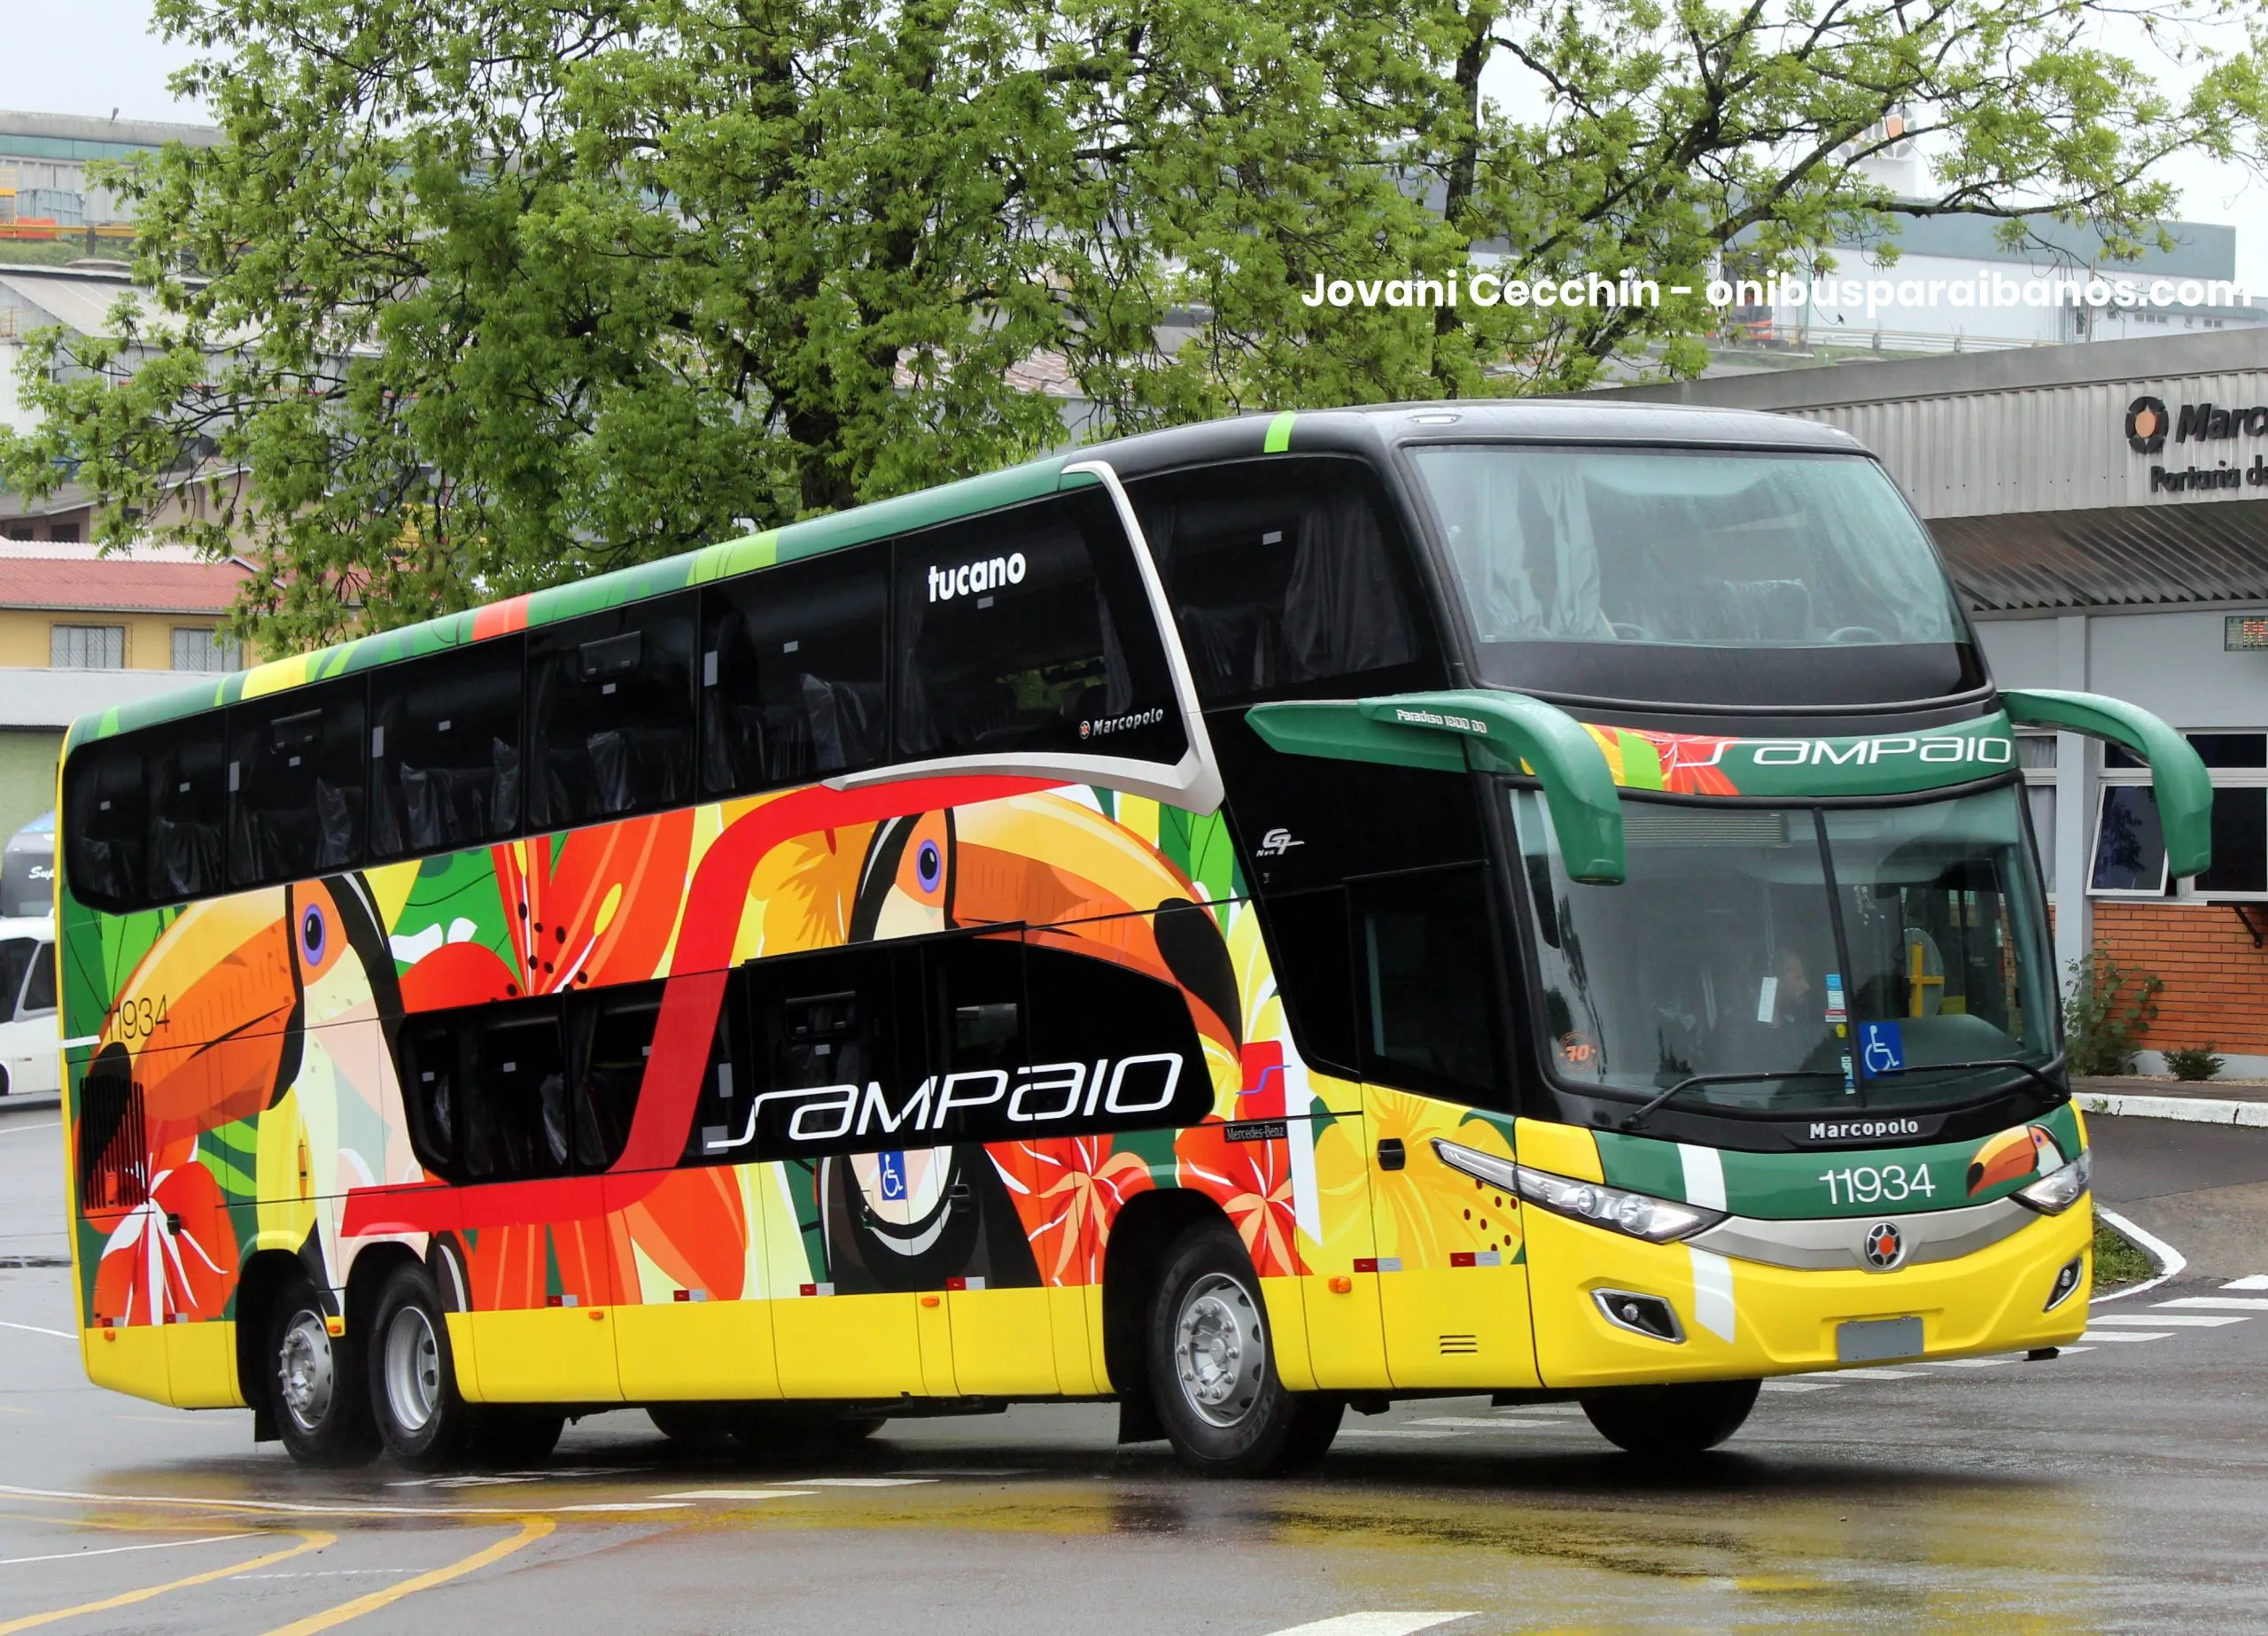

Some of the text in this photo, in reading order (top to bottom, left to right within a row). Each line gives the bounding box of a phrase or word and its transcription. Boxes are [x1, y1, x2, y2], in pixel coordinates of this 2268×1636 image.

[2175, 403, 2268, 443] Marc
[2150, 460, 2241, 492] Portaria
[928, 552, 1027, 603] tucano
[1092, 708, 1164, 736] Marcopolo
[1395, 709, 1443, 725] Paradiso
[1675, 736, 2012, 768] SAMPAIO
[104, 994, 171, 1043] 11934
[706, 1052, 1184, 1149] SAMPAIO
[1226, 1124, 1285, 1142] Mercedes-Benz
[1809, 1119, 1919, 1139] Marcopolo
[1818, 1163, 1937, 1205] 11934
